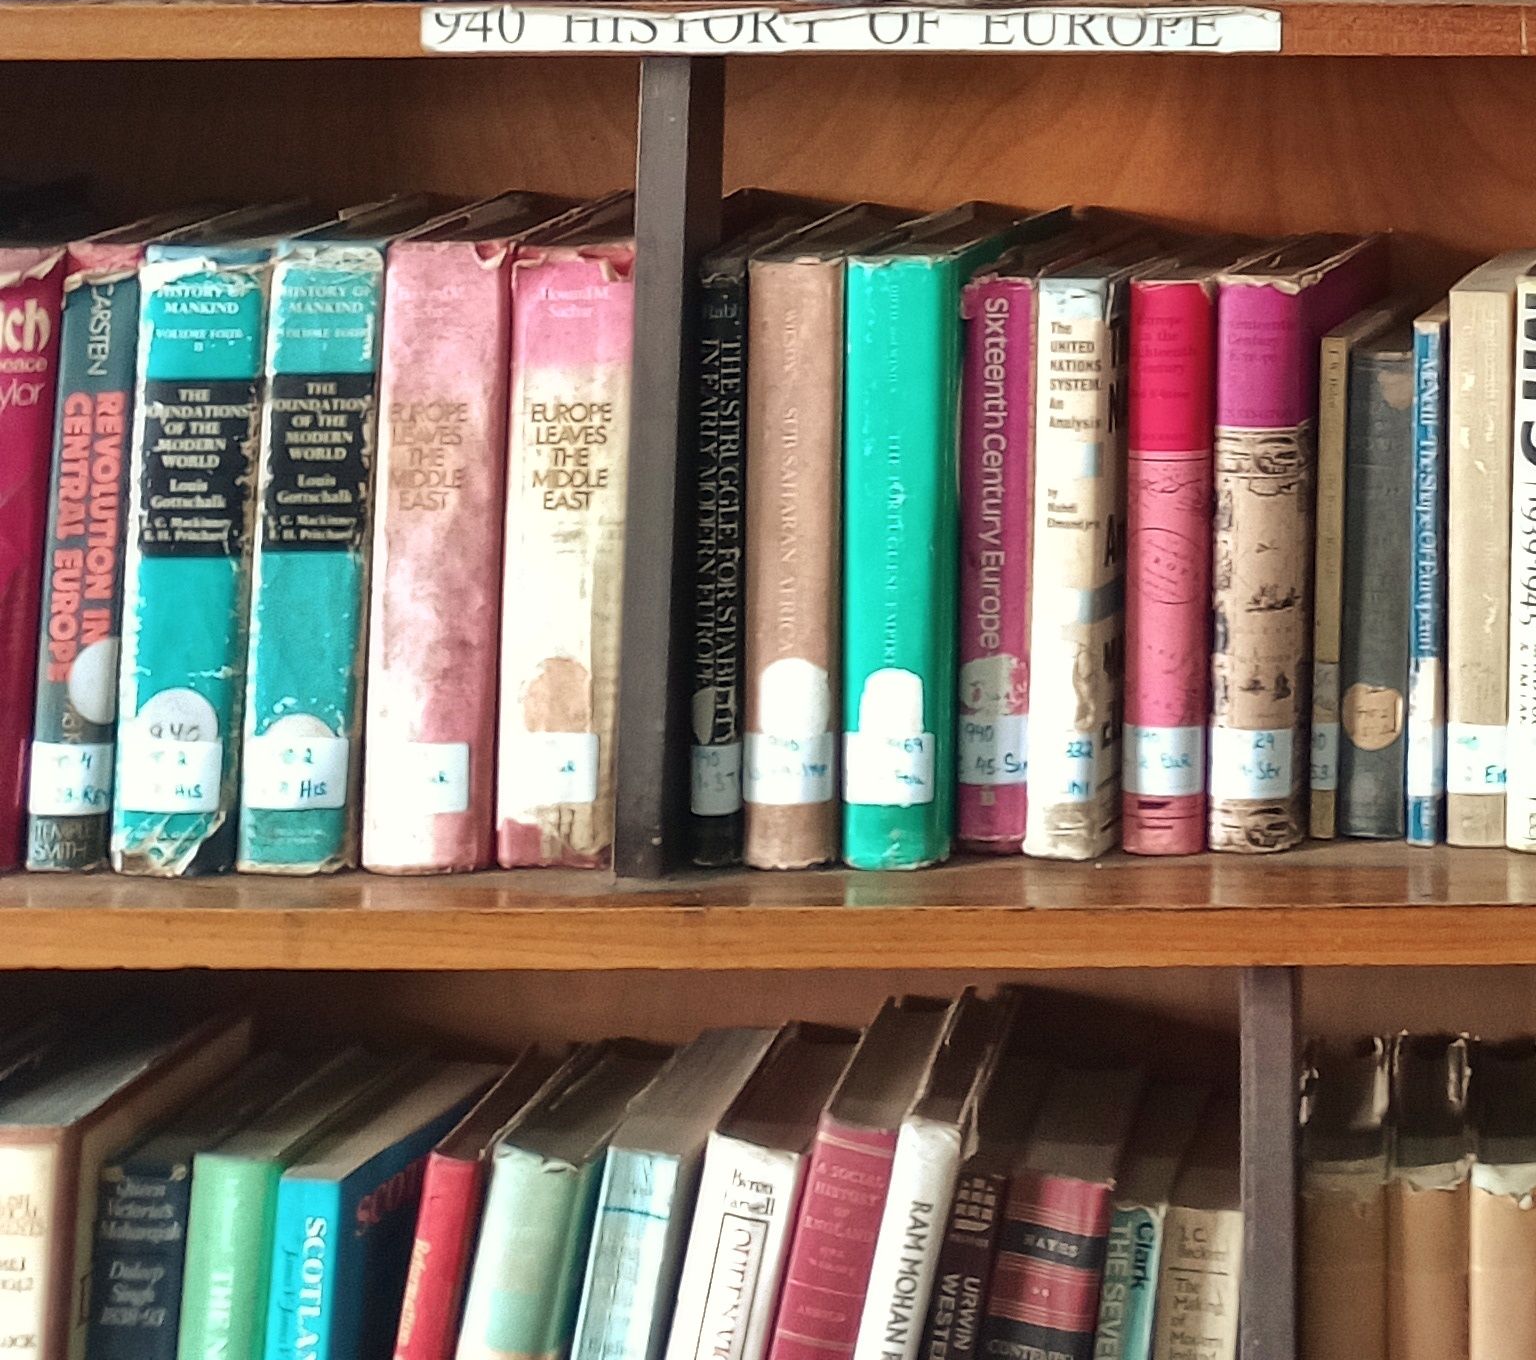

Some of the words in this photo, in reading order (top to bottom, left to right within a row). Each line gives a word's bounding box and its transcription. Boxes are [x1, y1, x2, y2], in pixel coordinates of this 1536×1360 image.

[867, 11, 942, 45] OF
[977, 11, 1224, 48] EUROPE
[982, 296, 1009, 427] Sixteenth
[1049, 340, 1095, 355] UNITED
[178, 388, 210, 402] THE
[530, 402, 614, 425] EUROPE
[534, 425, 610, 447] LEAVES
[55, 391, 94, 540] CENTRAL
[161, 454, 220, 469] WORLD
[551, 447, 591, 468] THE
[83, 390, 129, 599] REVOLUTION
[531, 469, 610, 490] MIDDLE
[982, 427, 1007, 549] Century
[542, 490, 595, 512] EAST
[979, 551, 1005, 651] Europe
[900, 1200, 934, 1257] RAM
[884, 1258, 923, 1350] MOHAN
[953, 1276, 982, 1352] URWIN
